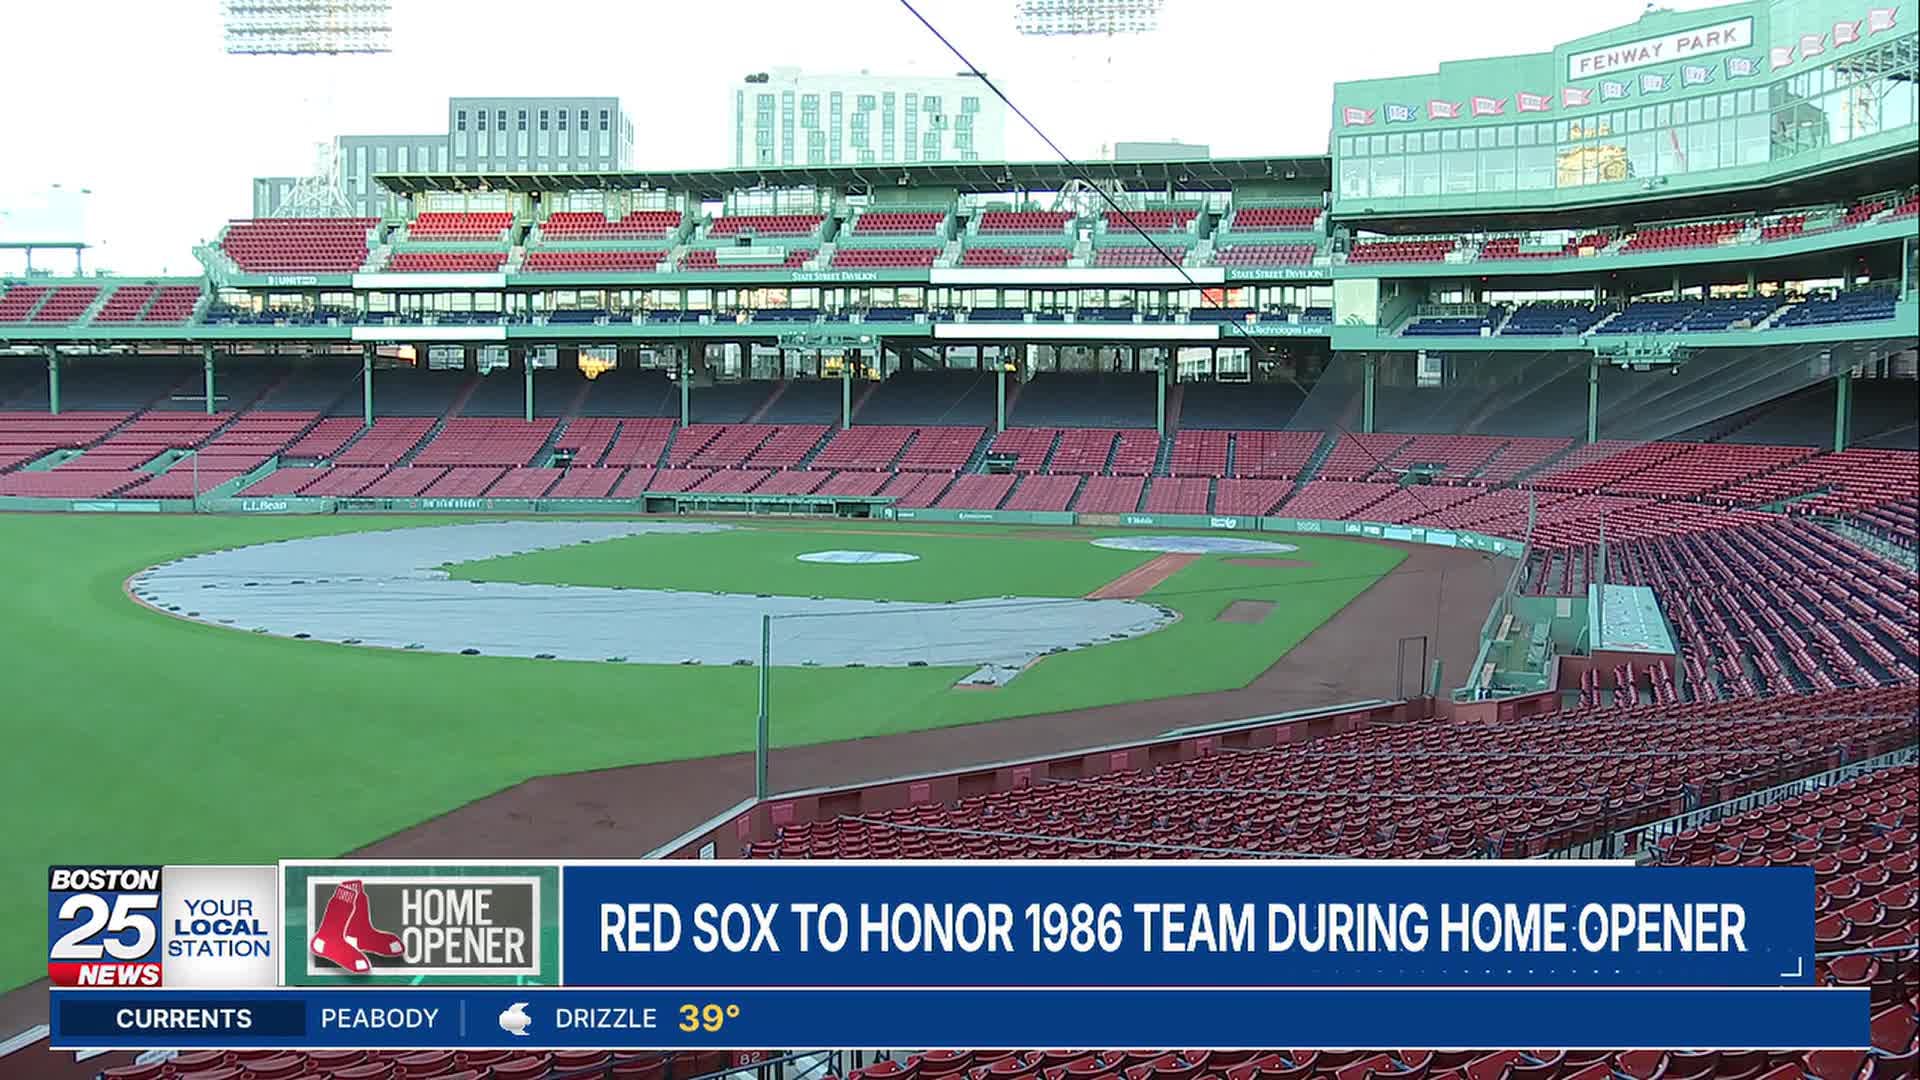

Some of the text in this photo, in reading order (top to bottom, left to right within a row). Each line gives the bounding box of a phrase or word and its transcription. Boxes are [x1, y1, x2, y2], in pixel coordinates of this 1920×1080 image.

[1580, 27, 1737, 72] FENWAY PARK
[279, 276, 317, 285] UNITED
[243, 500, 287, 511] L.L.Bean
[740, 1052, 761, 1065] 82
